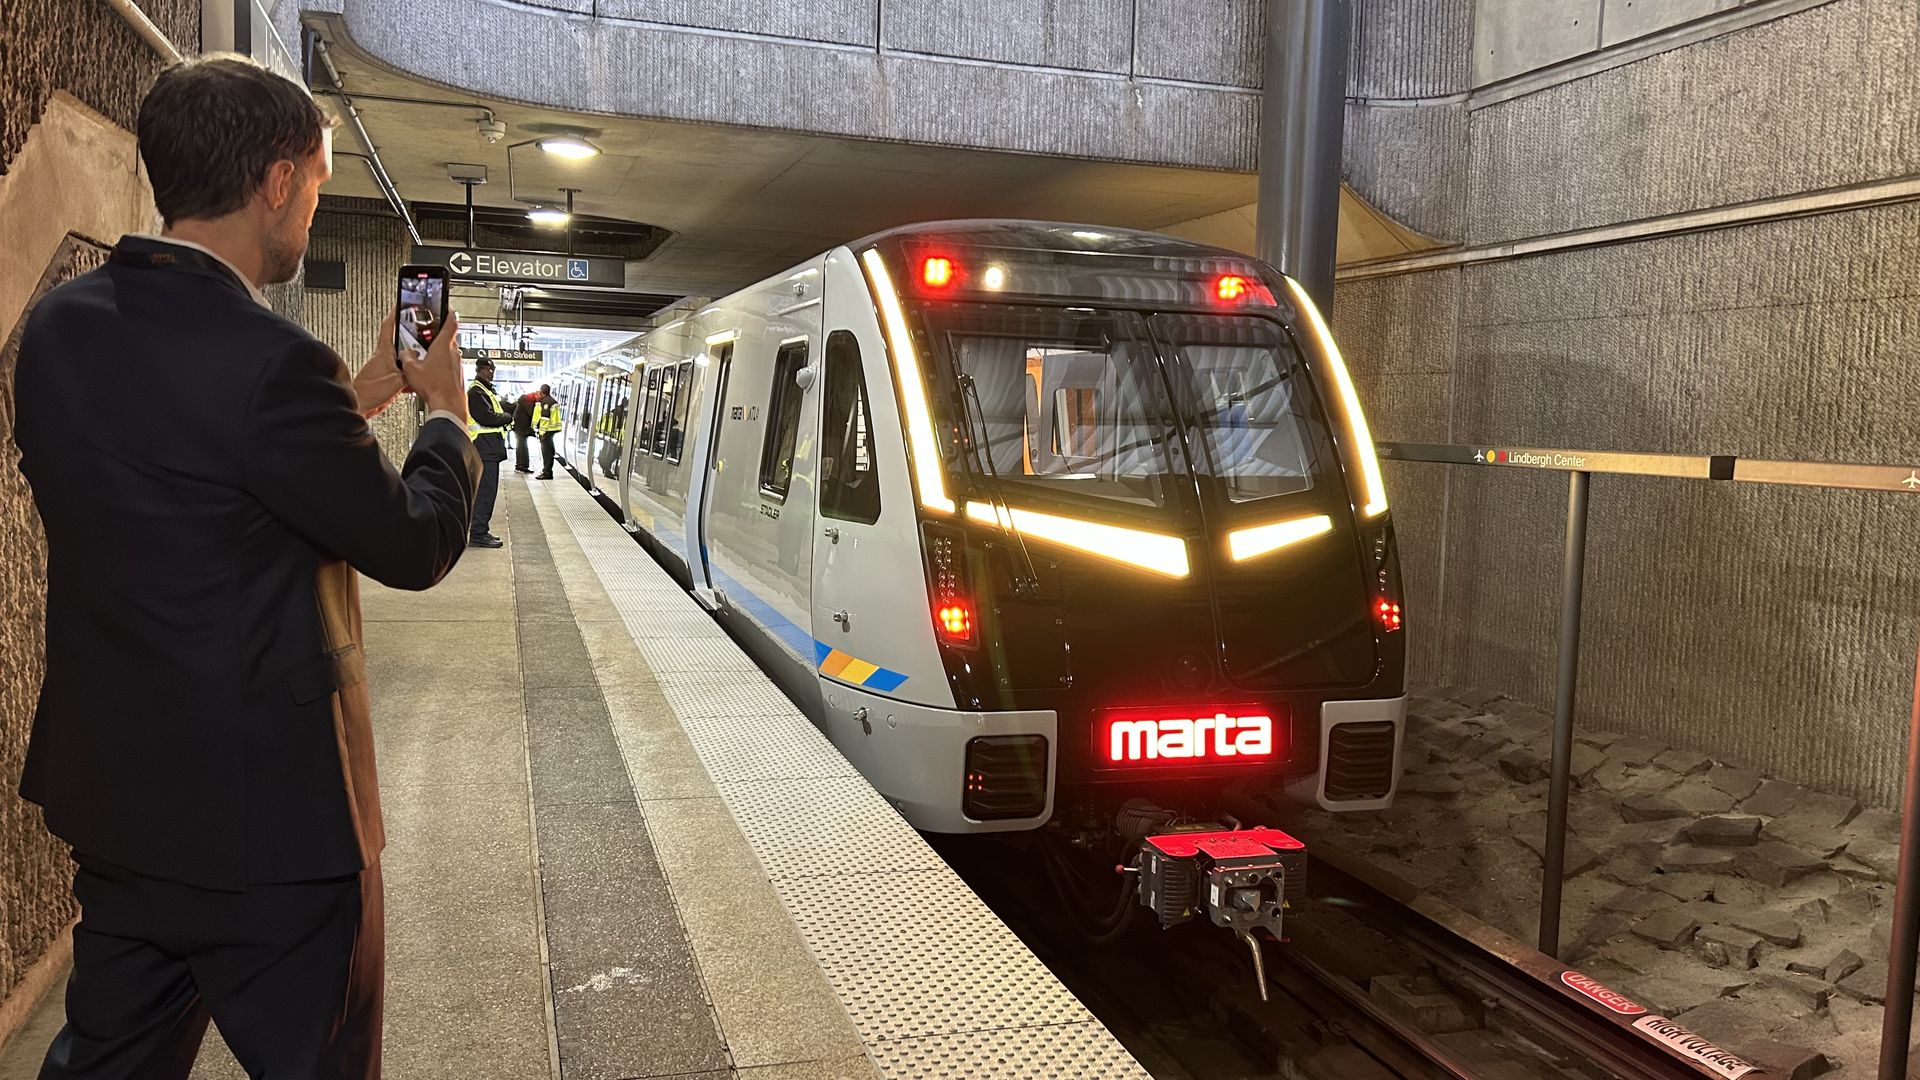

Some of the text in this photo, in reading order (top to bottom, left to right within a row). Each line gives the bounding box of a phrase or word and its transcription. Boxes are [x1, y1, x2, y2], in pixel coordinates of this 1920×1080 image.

[476, 255, 562, 277] Elevator
[503, 351, 536, 360] To Street
[1508, 451, 1585, 468] Lindbergh Center
[1111, 713, 1272, 761] marta
[1567, 974, 1638, 1011] DANGER
[1645, 1018, 1750, 1072] HIGH VOLTAGE
